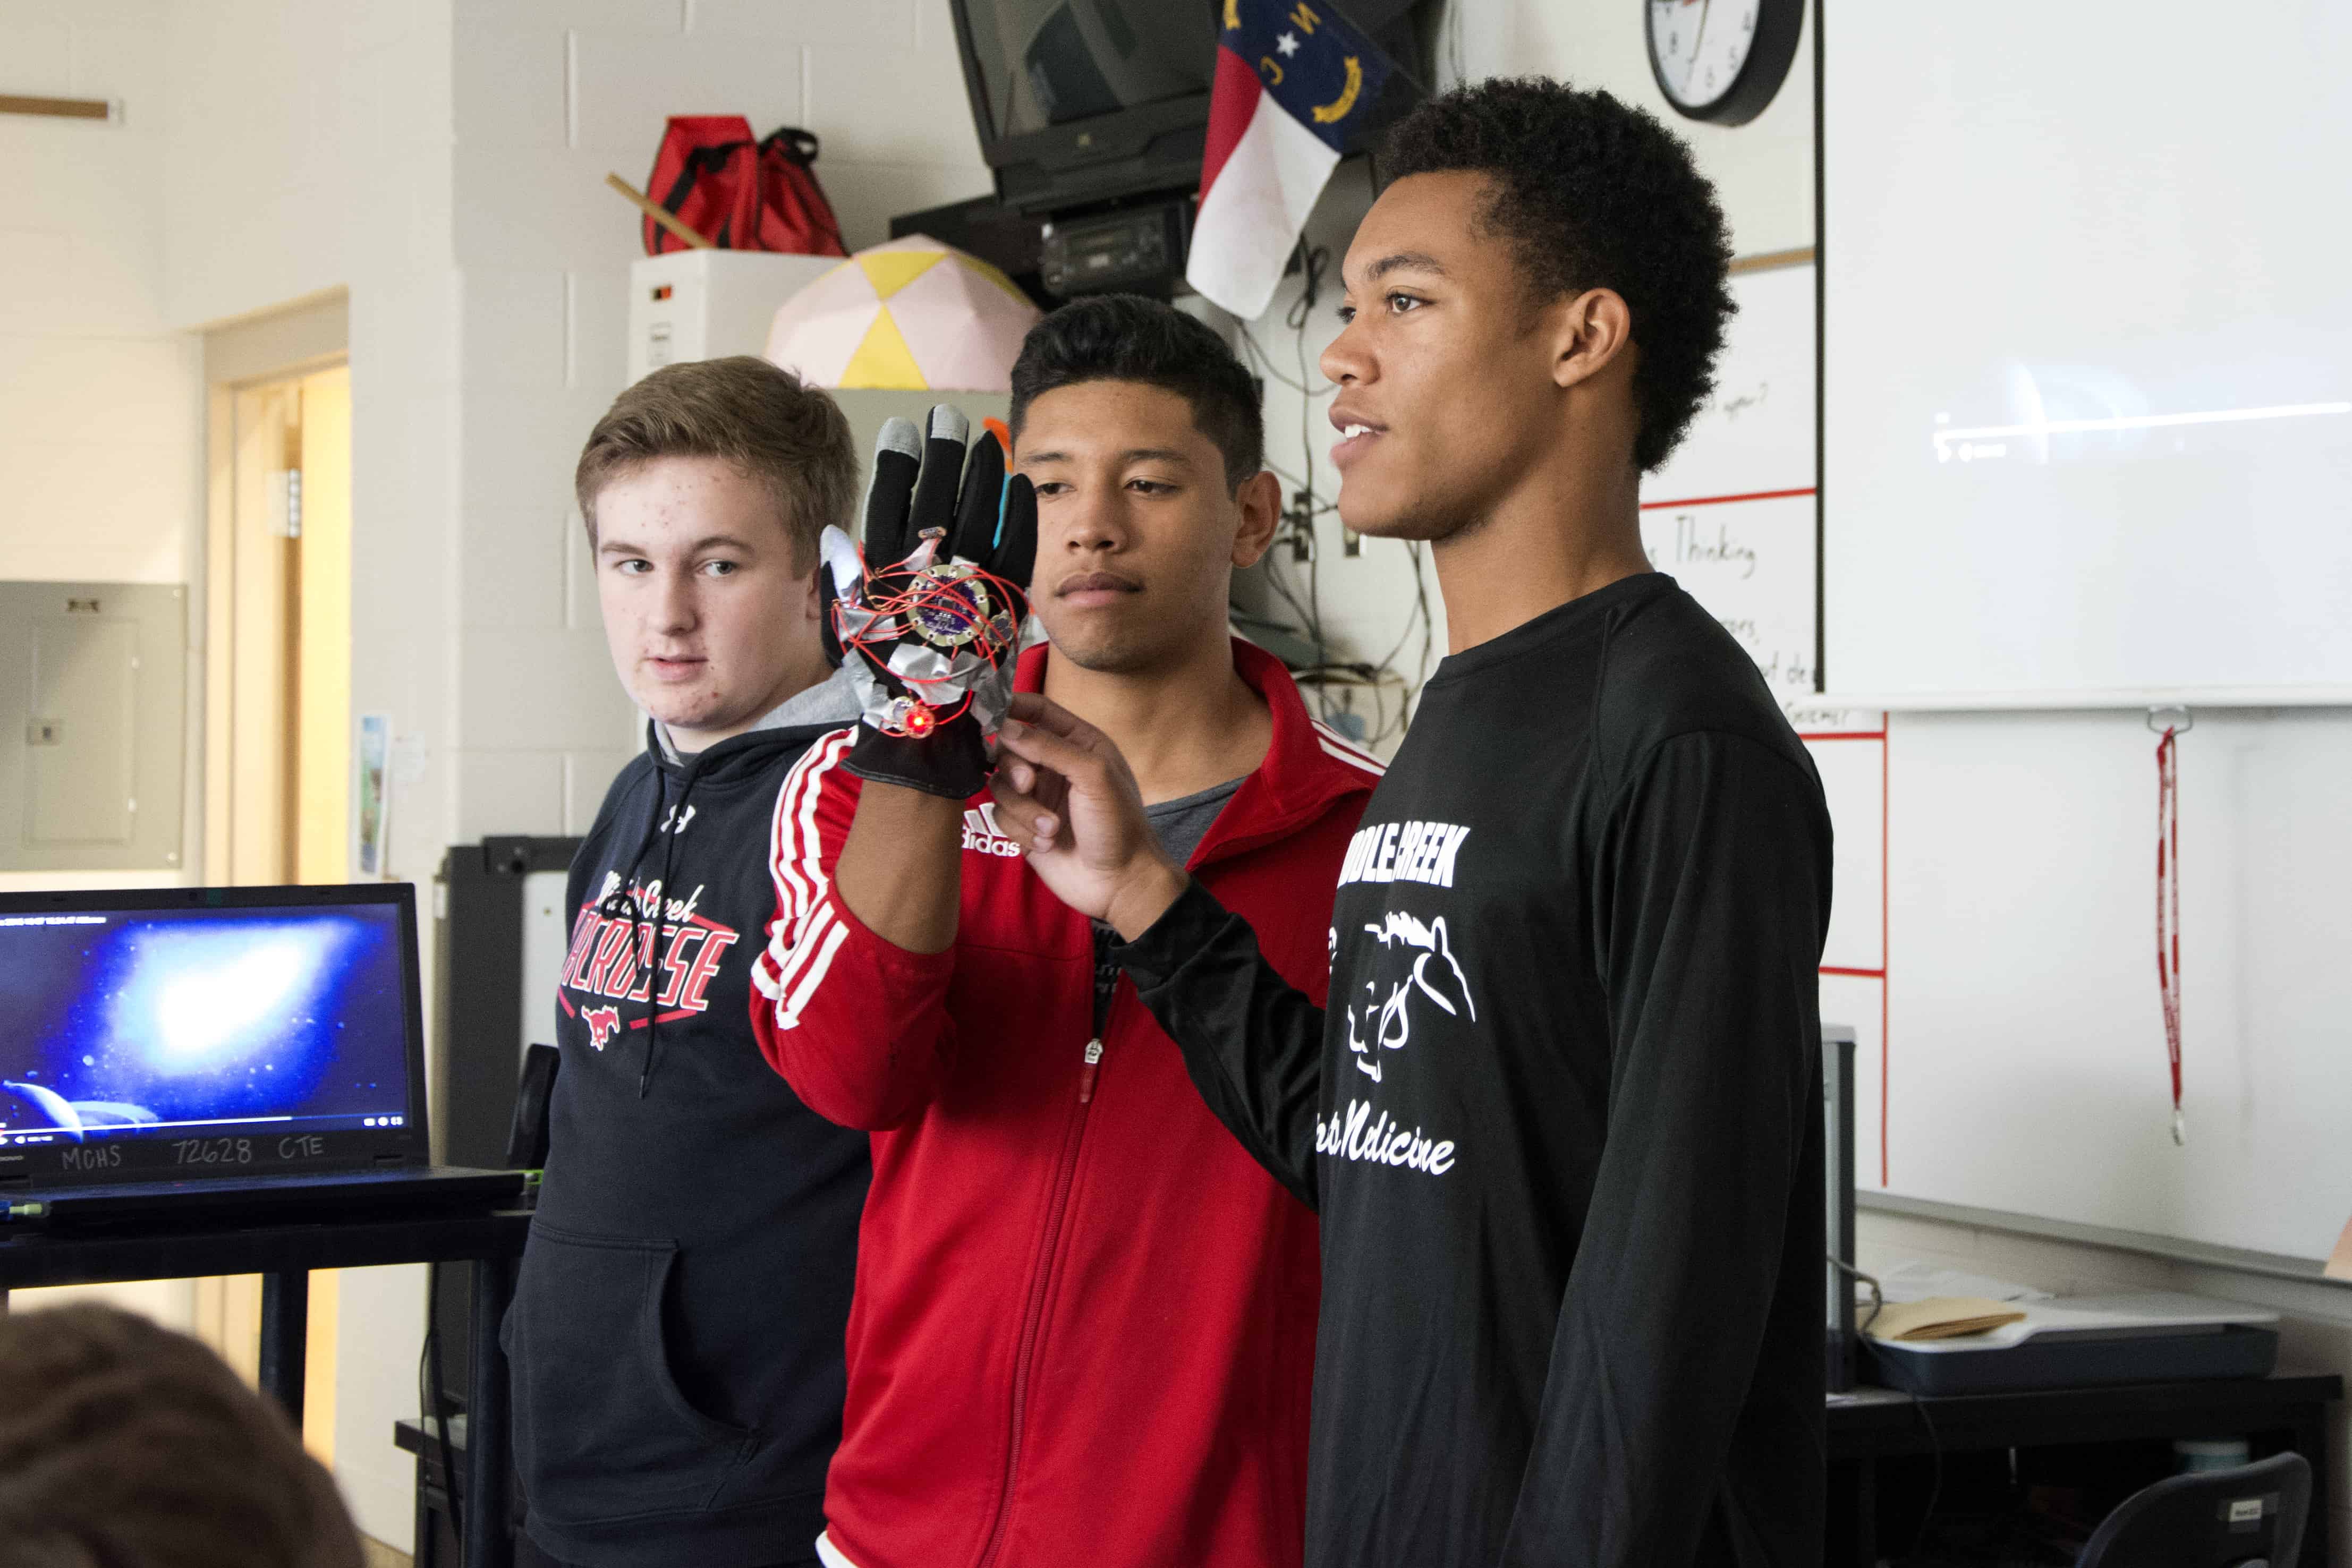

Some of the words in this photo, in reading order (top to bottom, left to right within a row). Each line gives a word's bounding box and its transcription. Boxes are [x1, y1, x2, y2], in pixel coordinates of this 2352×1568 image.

[1676, 514, 1756, 580] Thinking
[561, 908, 740, 1012] ACROSSE
[171, 1138, 252, 1164] 72628
[278, 1134, 324, 1160] CTE
